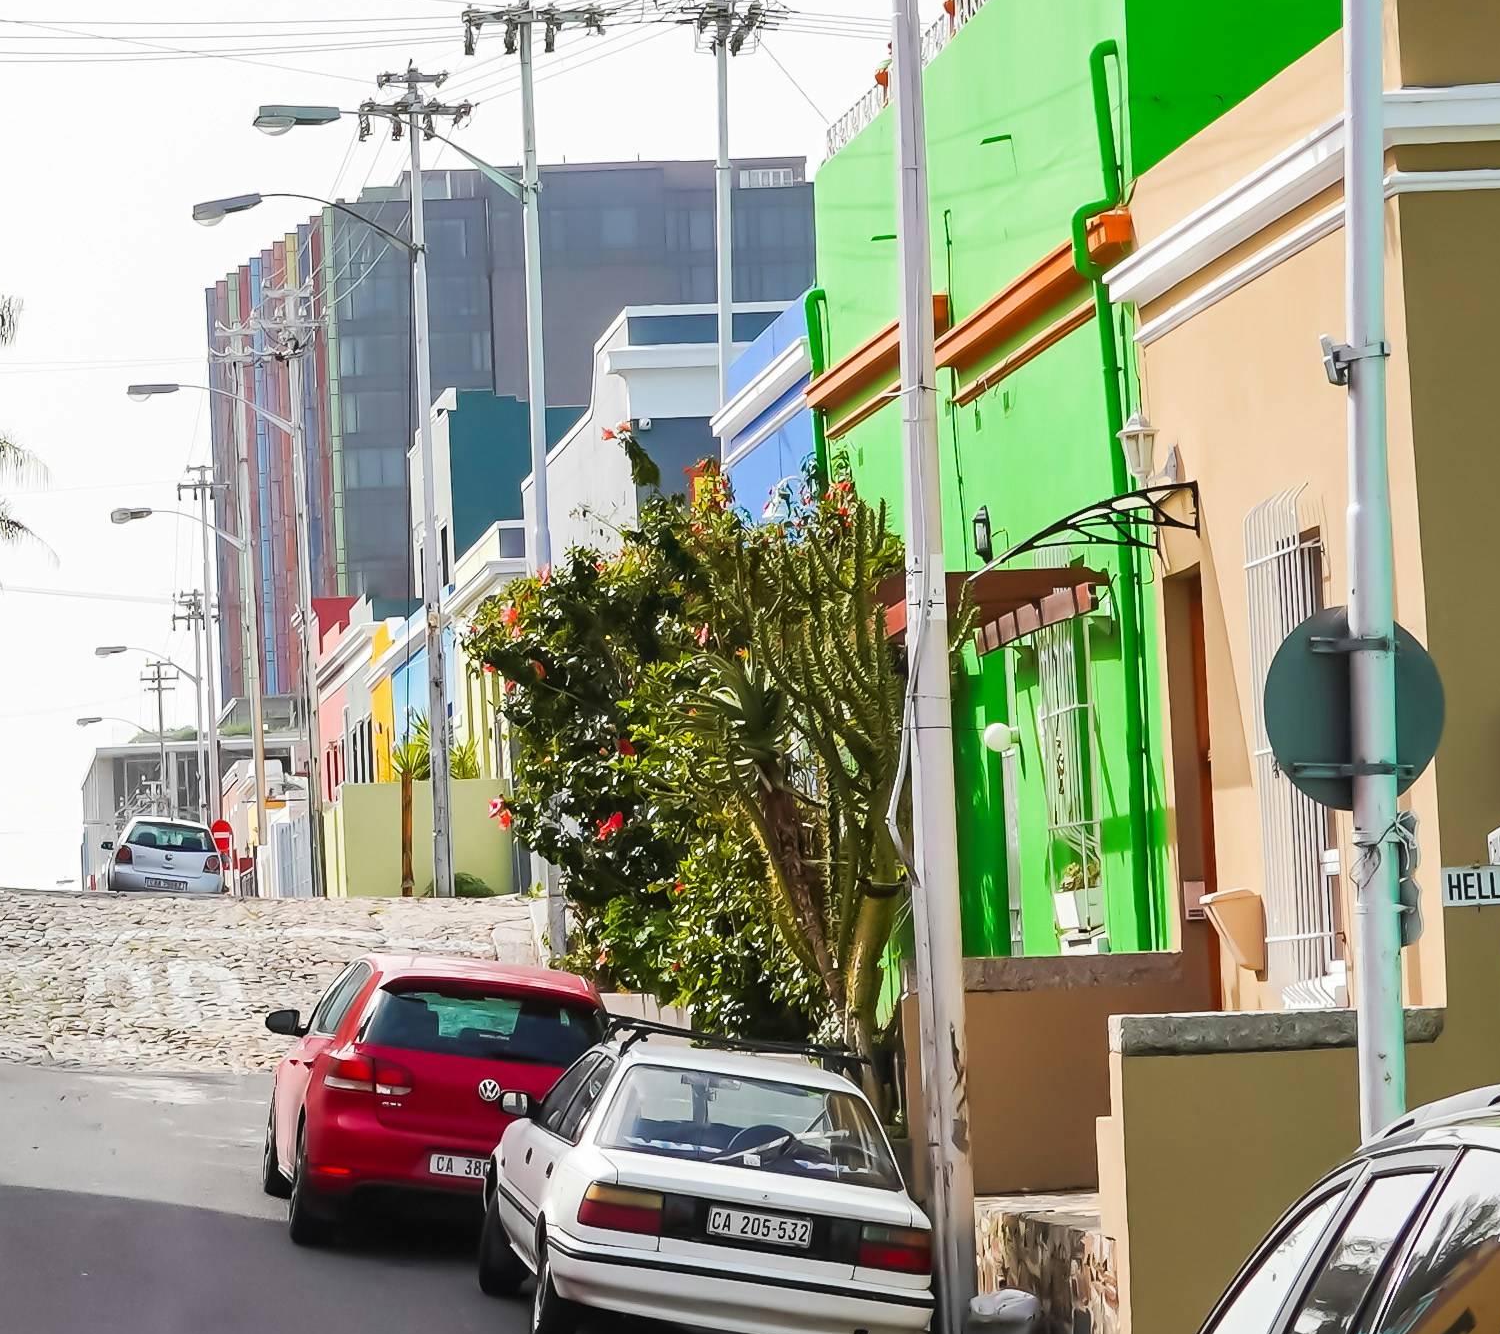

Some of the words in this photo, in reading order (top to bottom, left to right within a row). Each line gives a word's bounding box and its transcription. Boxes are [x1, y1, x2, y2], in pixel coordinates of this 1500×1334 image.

[436, 1156, 454, 1174] CA
[711, 1211, 732, 1232] CA
[740, 1215, 809, 1243] 205-532
